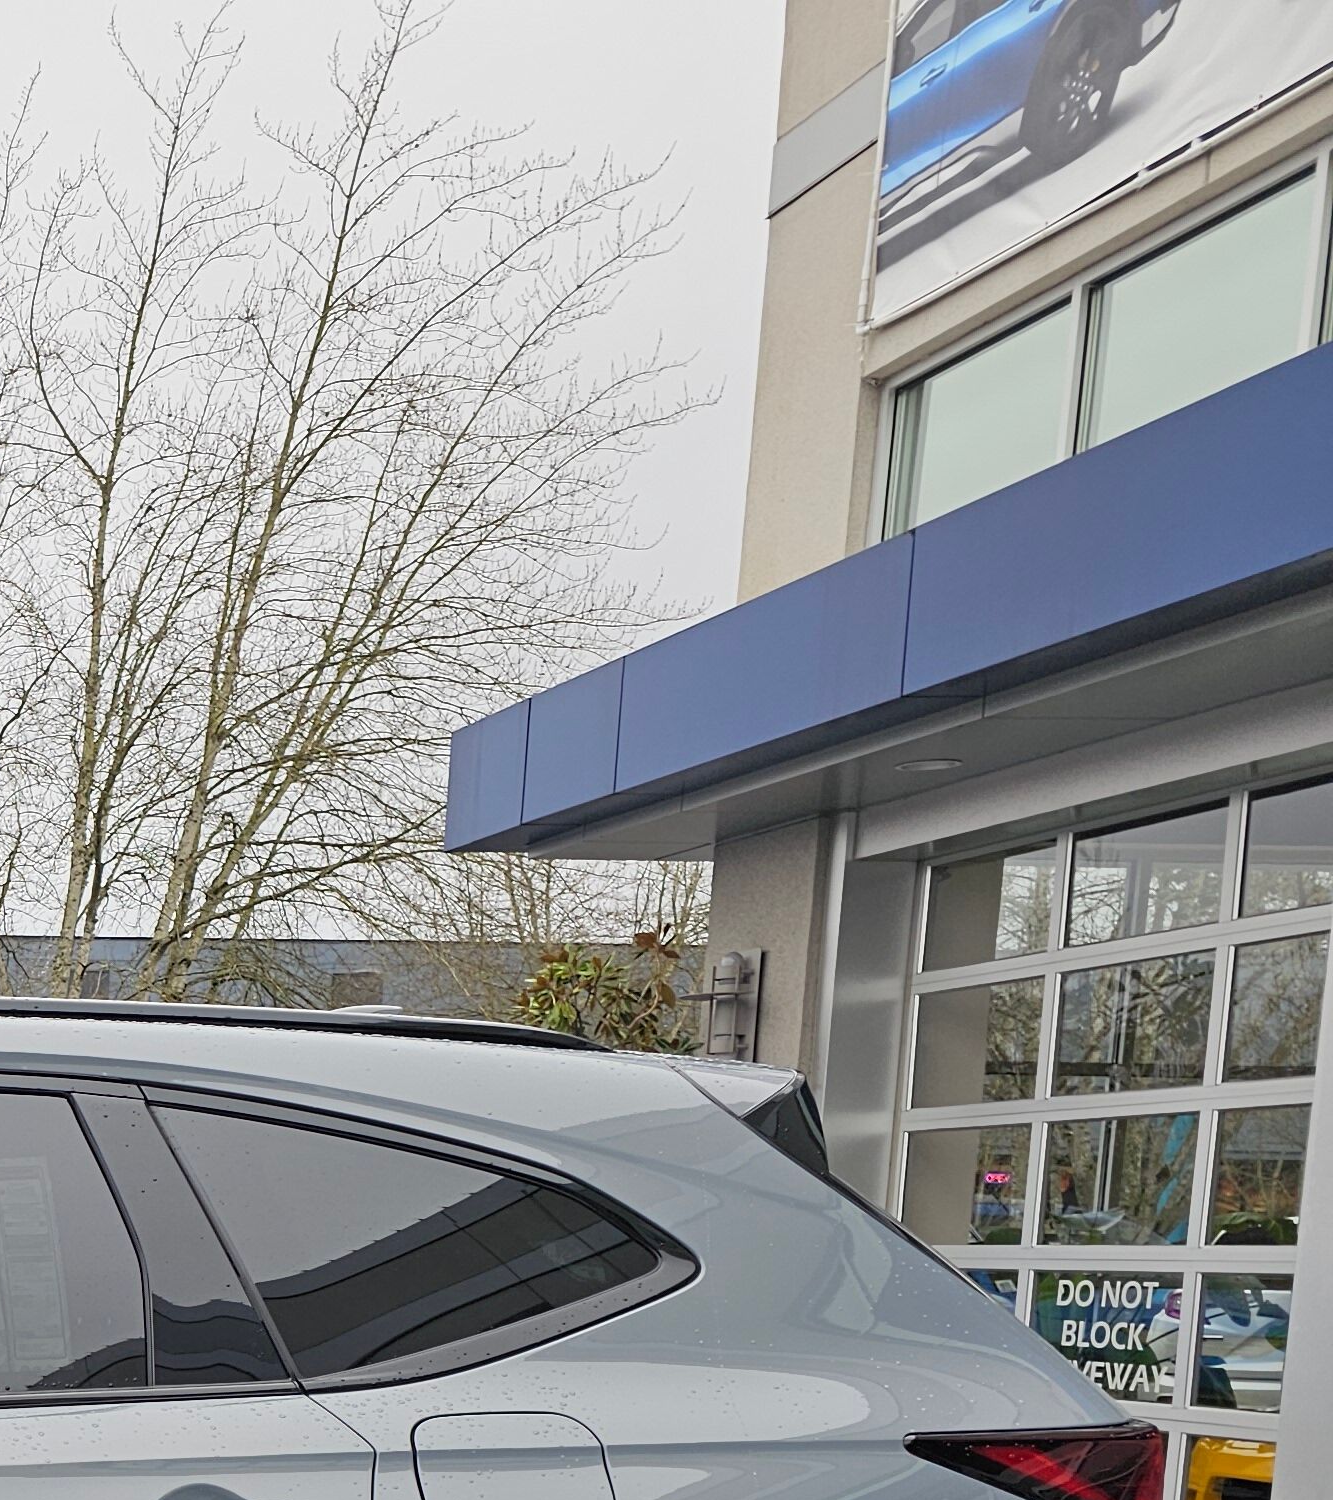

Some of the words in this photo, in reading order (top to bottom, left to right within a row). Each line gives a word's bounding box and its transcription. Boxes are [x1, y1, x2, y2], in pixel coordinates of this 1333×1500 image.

[1056, 1279, 1095, 1308] DO
[1100, 1280, 1160, 1309] NOT
[1060, 1319, 1146, 1351] BLOCK
[1071, 1359, 1168, 1393] VEWAY
